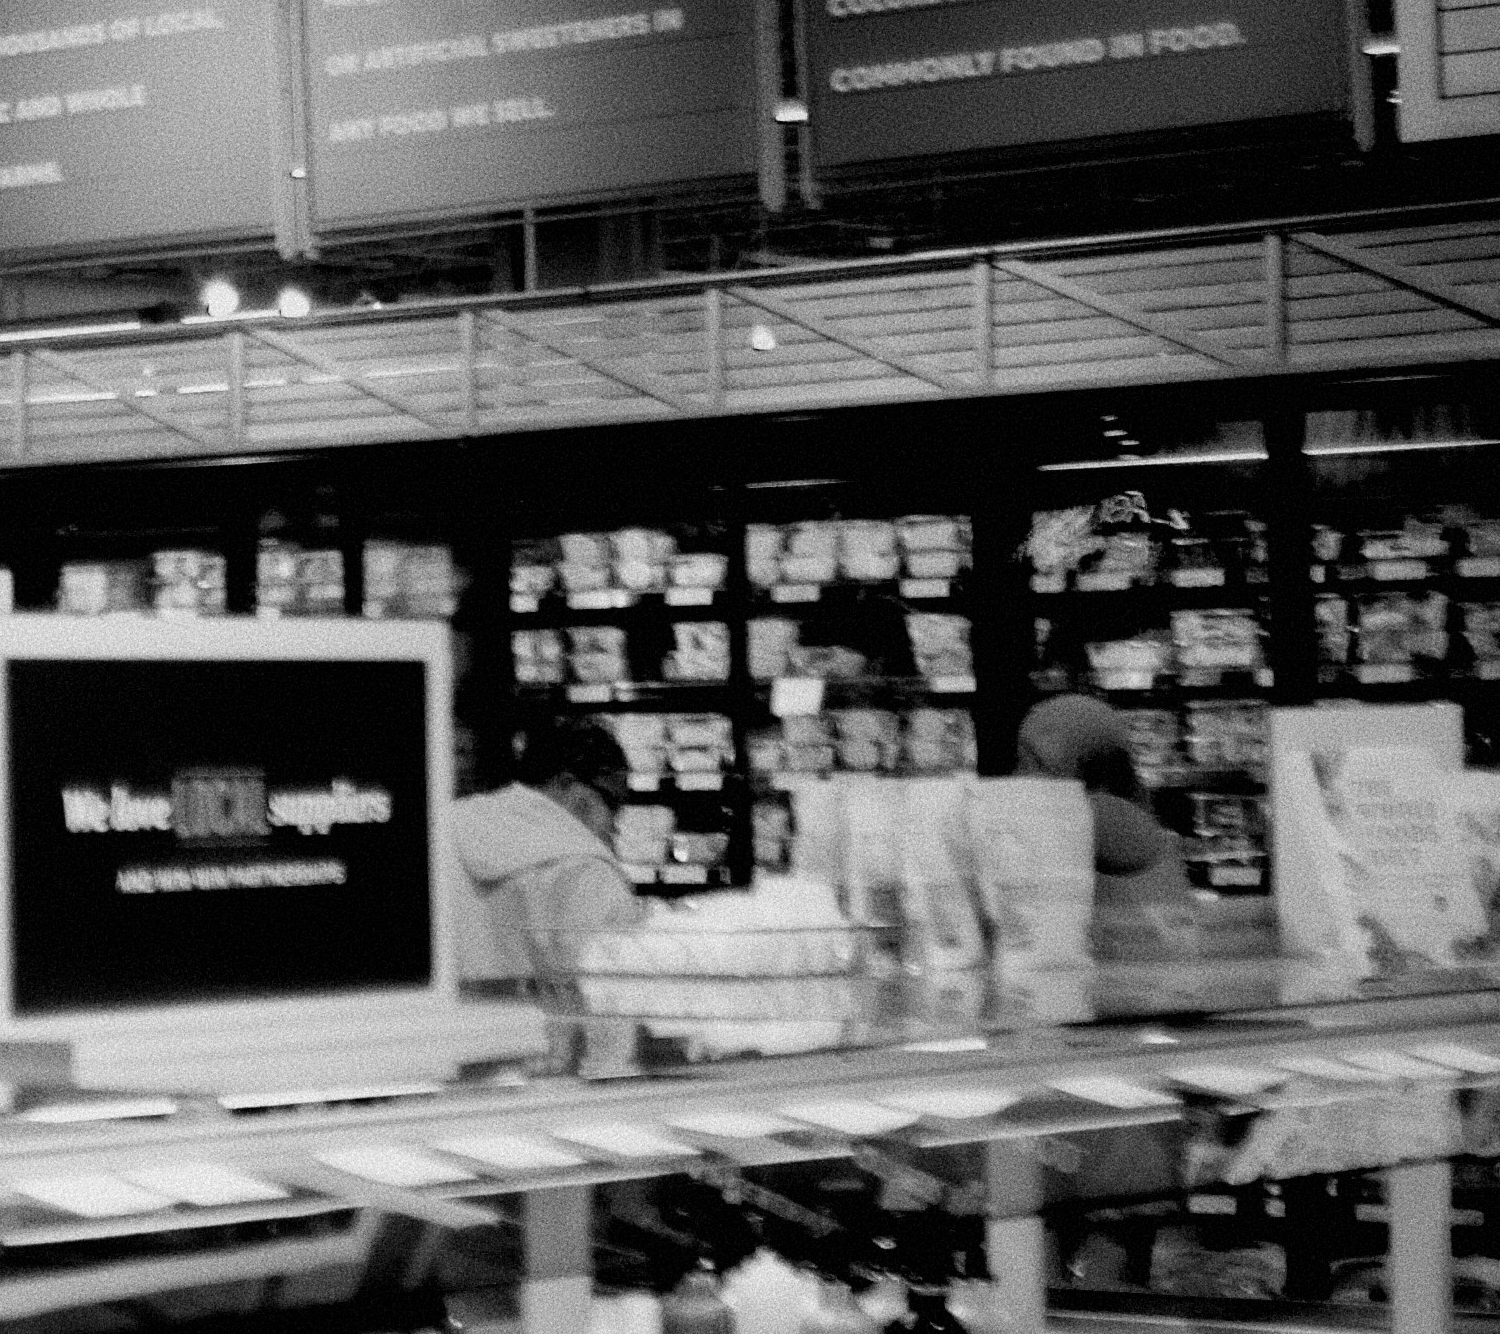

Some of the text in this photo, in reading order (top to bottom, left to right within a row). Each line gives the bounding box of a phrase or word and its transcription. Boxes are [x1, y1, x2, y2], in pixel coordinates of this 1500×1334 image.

[109, 18, 140, 41] OF
[325, 8, 682, 77] OR ARTIFICIAL SWEETENERS IN
[830, 50, 995, 92] COMMONLY
[1000, 38, 1103, 72] FOUND
[1108, 33, 1144, 59] IN
[15, 95, 62, 120] AND
[66, 85, 145, 114] WHOLE
[329, 118, 374, 142] ANY
[378, 110, 447, 135] FOOD
[452, 103, 489, 128] WE
